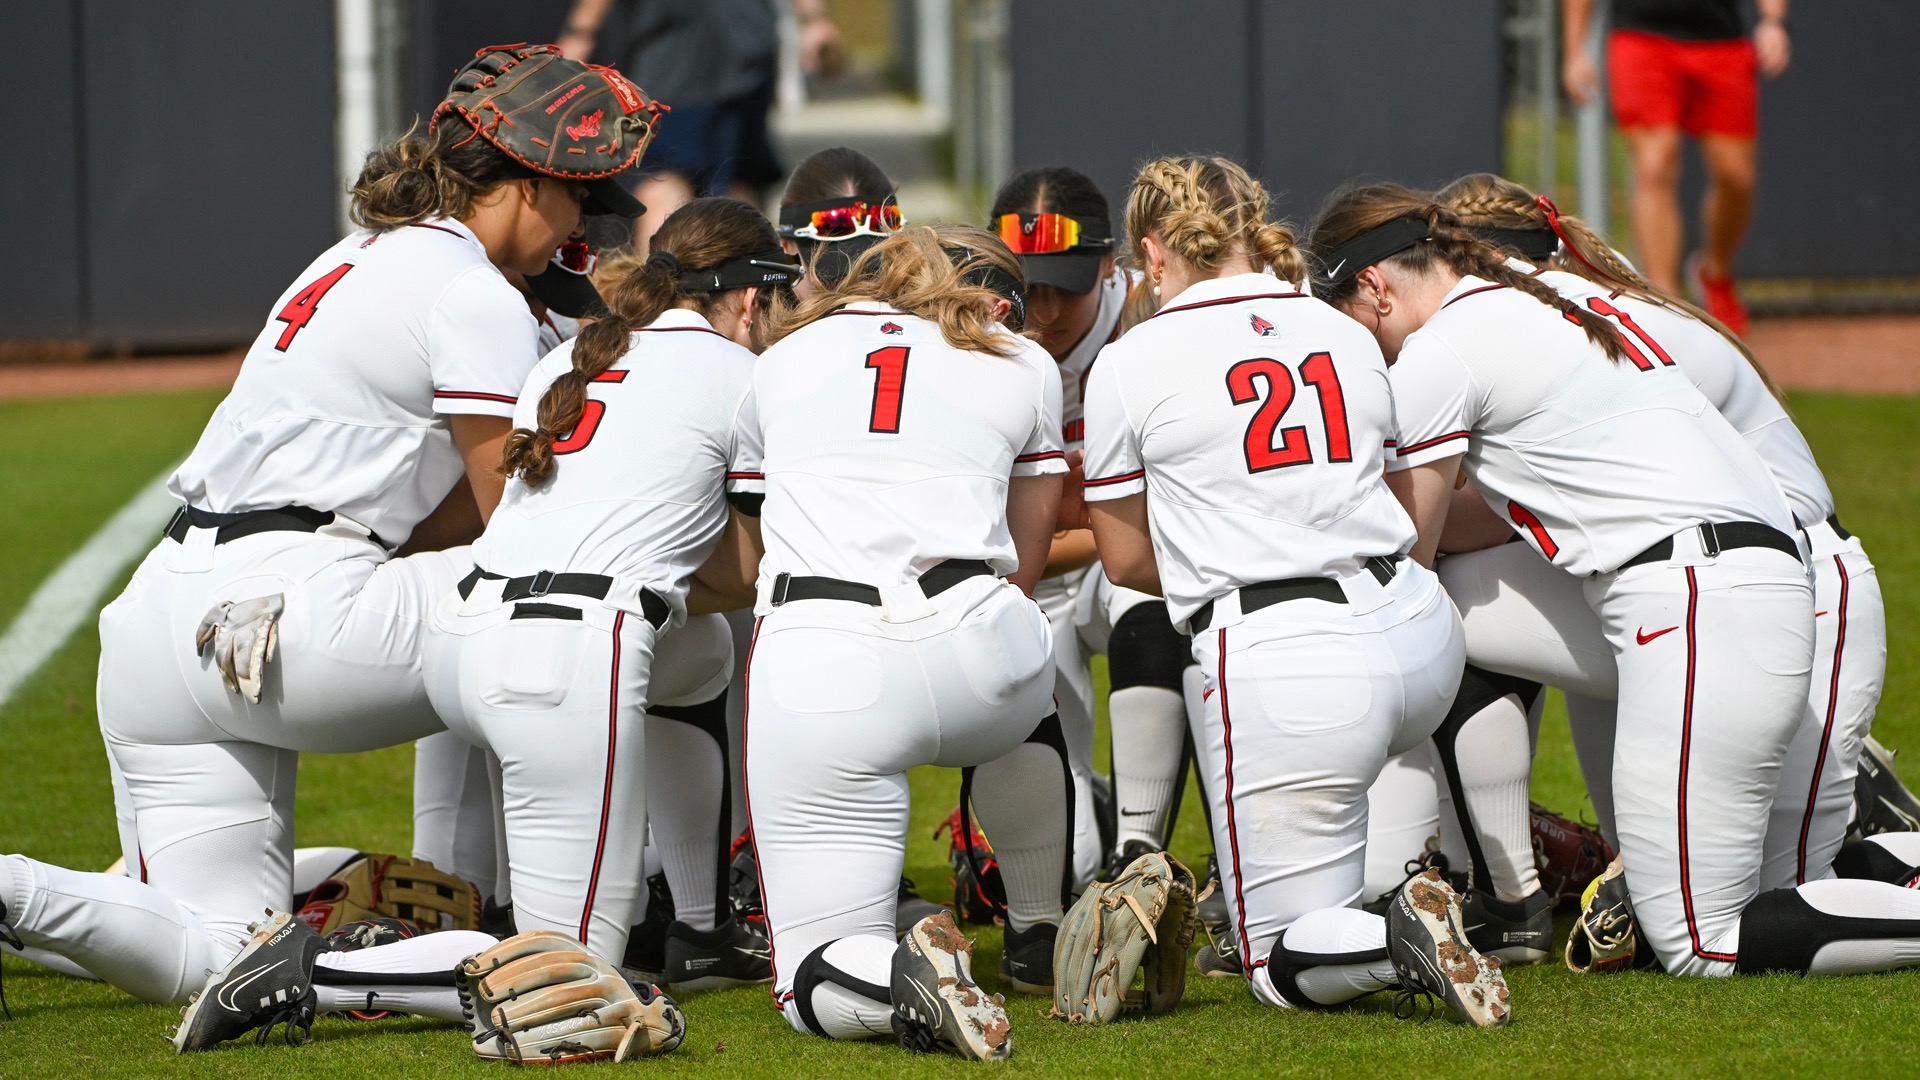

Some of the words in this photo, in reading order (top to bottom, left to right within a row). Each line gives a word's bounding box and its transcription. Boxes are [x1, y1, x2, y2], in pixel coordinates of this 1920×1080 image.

[274, 262, 355, 353] 4
[864, 345, 911, 434] 1
[1225, 351, 1353, 475] 21
[268, 926, 293, 947] renew
